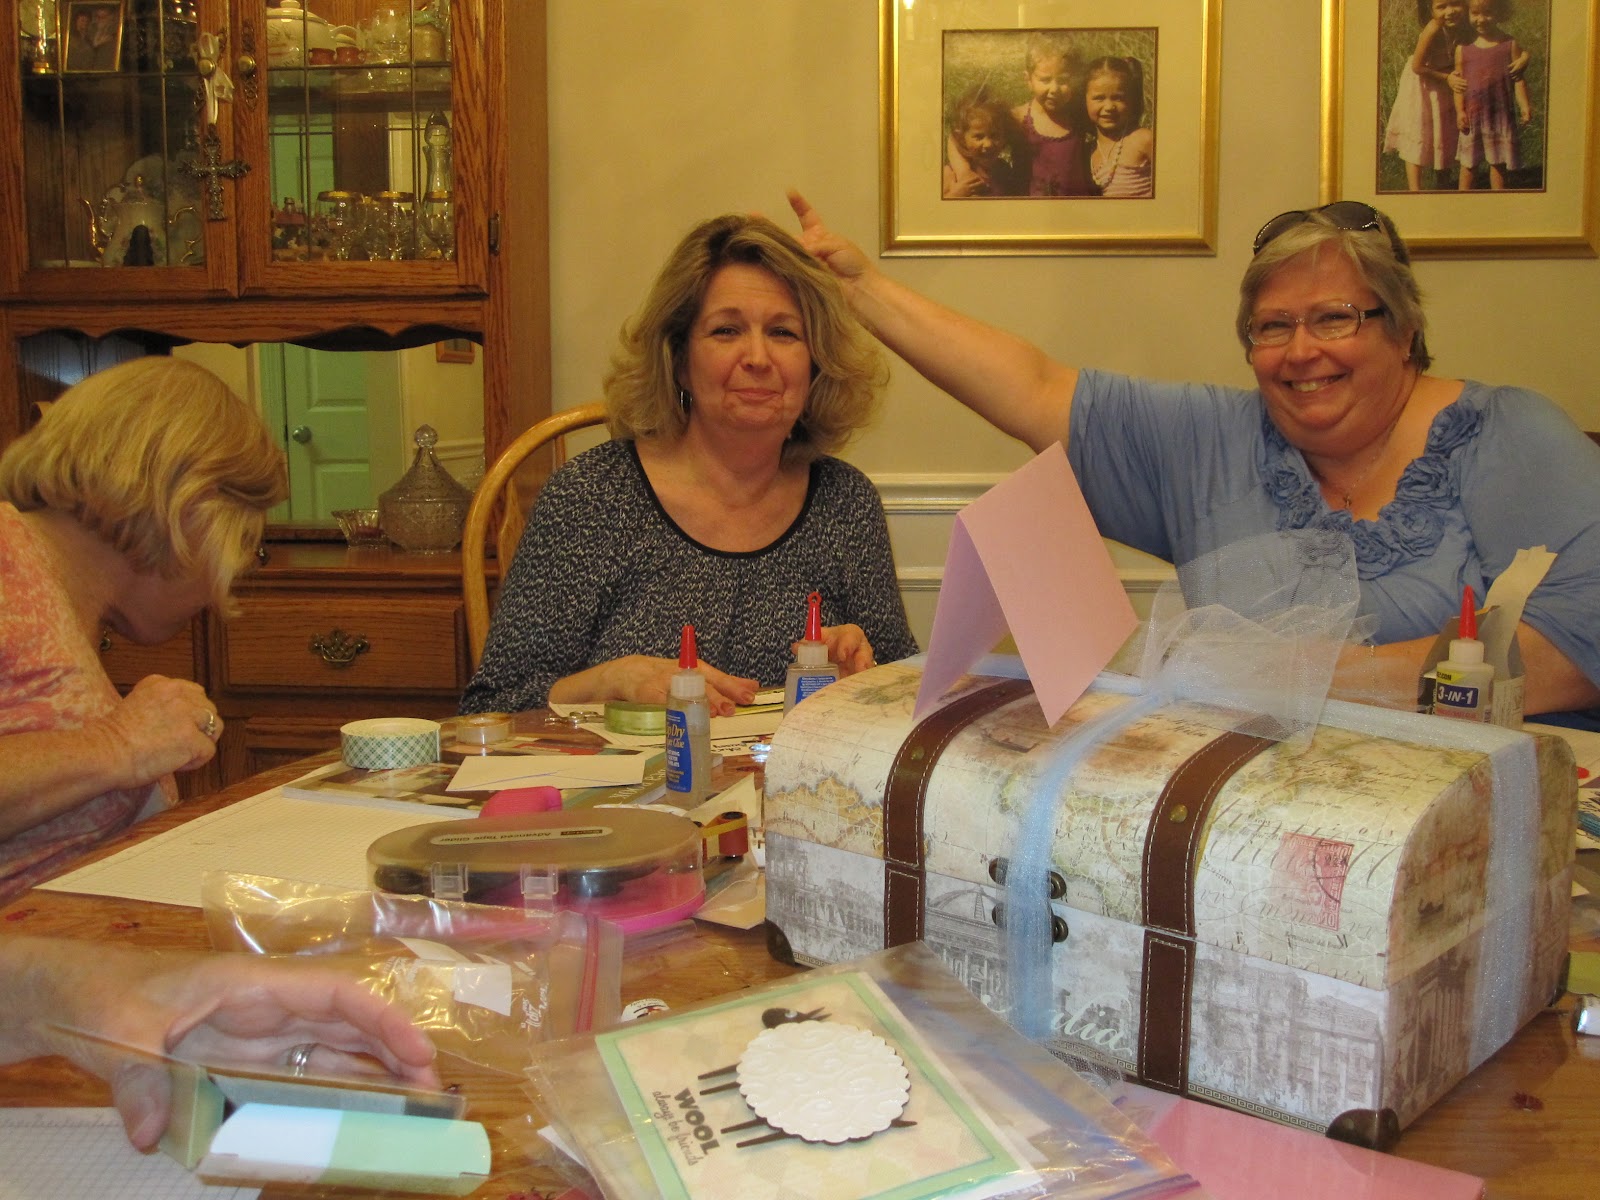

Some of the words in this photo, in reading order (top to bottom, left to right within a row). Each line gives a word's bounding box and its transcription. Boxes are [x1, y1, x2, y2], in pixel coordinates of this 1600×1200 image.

[1437, 685, 1474, 705] 3-IN-1
[672, 724, 686, 740] Dry
[652, 1090, 674, 1121] always
[668, 1120, 683, 1132] be
[674, 1087, 720, 1155] WOOL
[667, 1132, 704, 1167] friends
